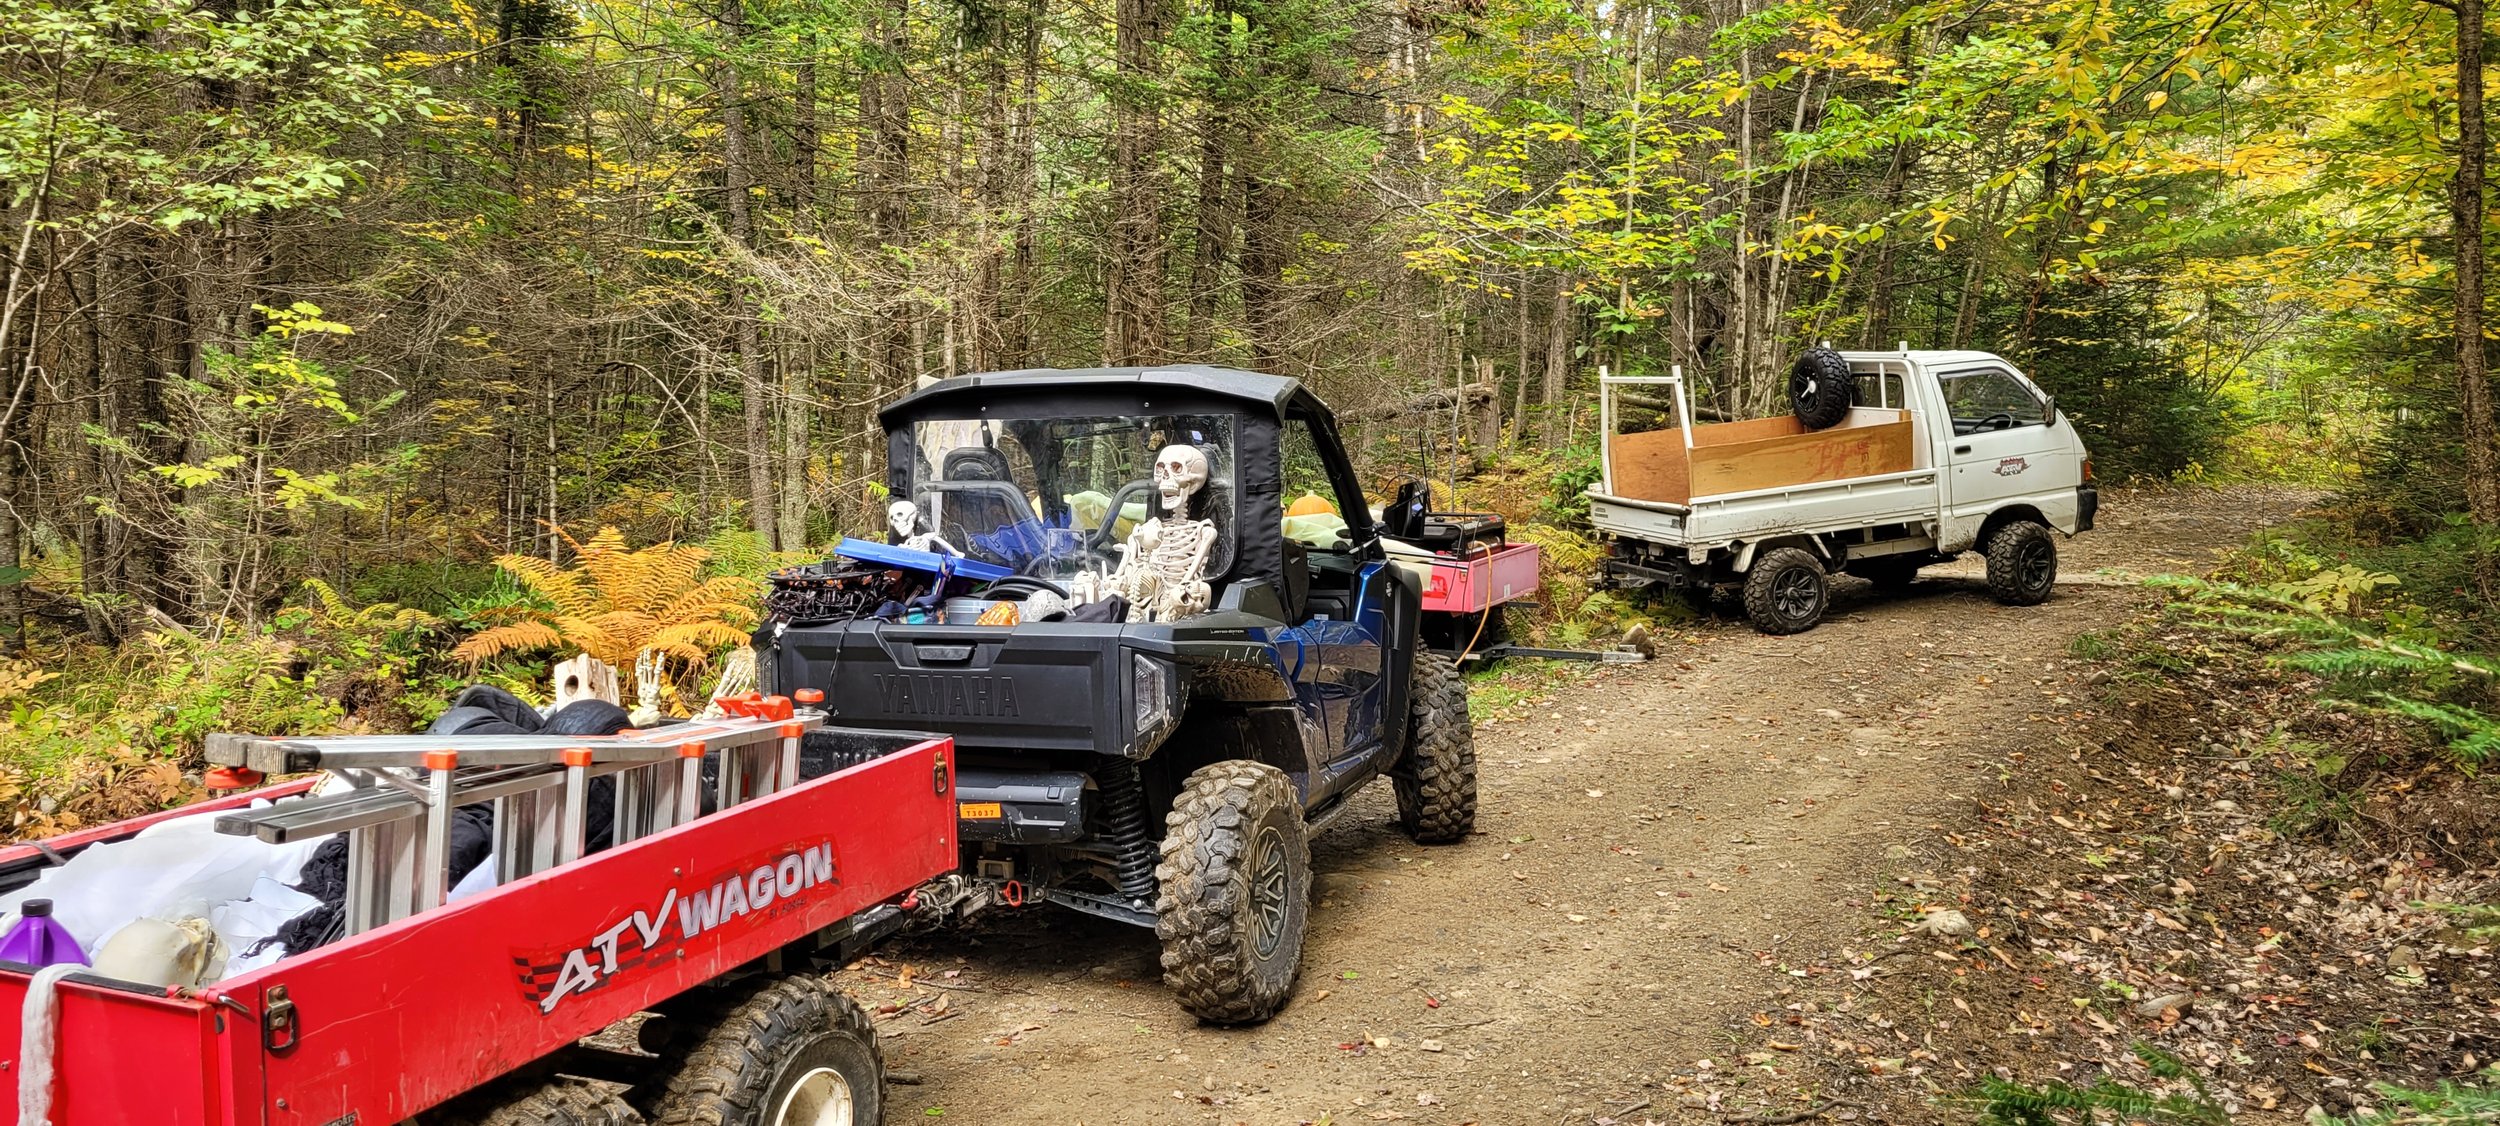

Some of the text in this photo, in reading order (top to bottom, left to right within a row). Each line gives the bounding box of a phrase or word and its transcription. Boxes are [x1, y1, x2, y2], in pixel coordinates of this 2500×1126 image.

[873, 673, 1020, 717] YAMAHA
[539, 841, 833, 1014] ATV WAGON
